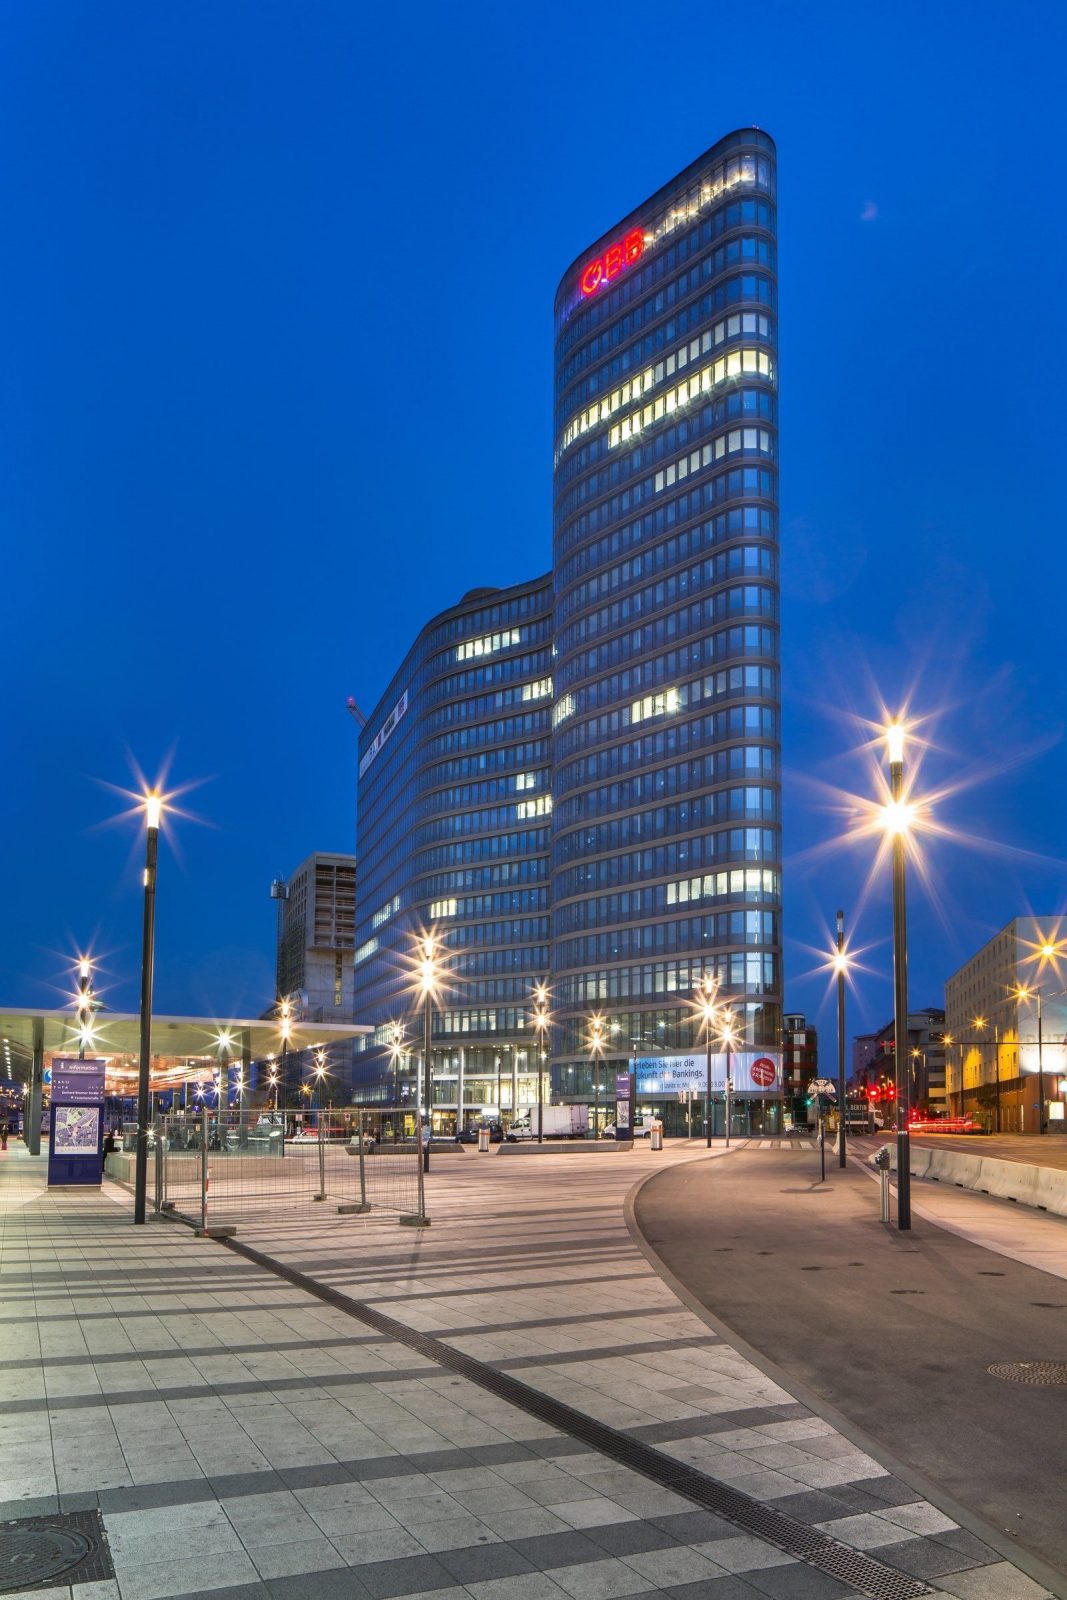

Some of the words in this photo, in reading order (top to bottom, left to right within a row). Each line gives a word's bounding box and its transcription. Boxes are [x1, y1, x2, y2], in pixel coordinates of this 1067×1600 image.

[635, 1061, 657, 1069] rleben
[684, 1059, 695, 1067] die
[636, 1071, 658, 1080] ukunft
[672, 1069, 704, 1079] Bankings.
